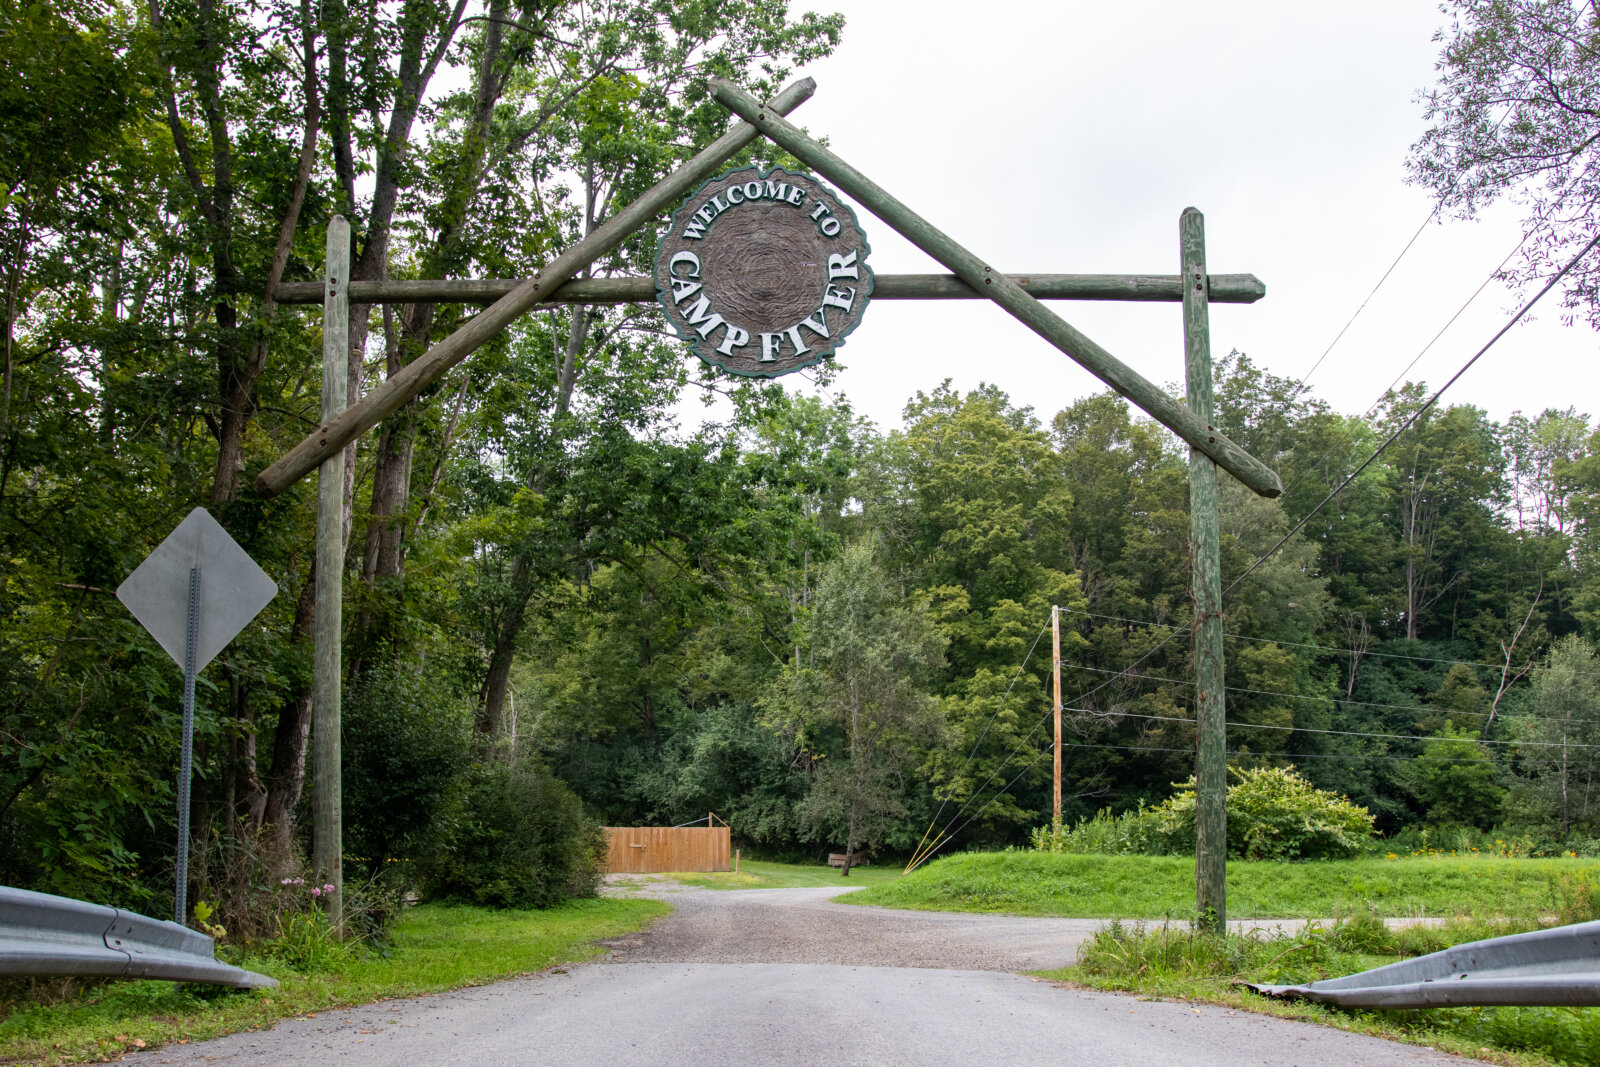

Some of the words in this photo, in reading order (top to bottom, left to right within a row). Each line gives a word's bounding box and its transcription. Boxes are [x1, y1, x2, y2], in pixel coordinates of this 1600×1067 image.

[682, 180, 806, 240] WELCOME
[809, 200, 841, 237] TO
[669, 251, 750, 357] CAMP
[758, 248, 859, 362] FIVER
